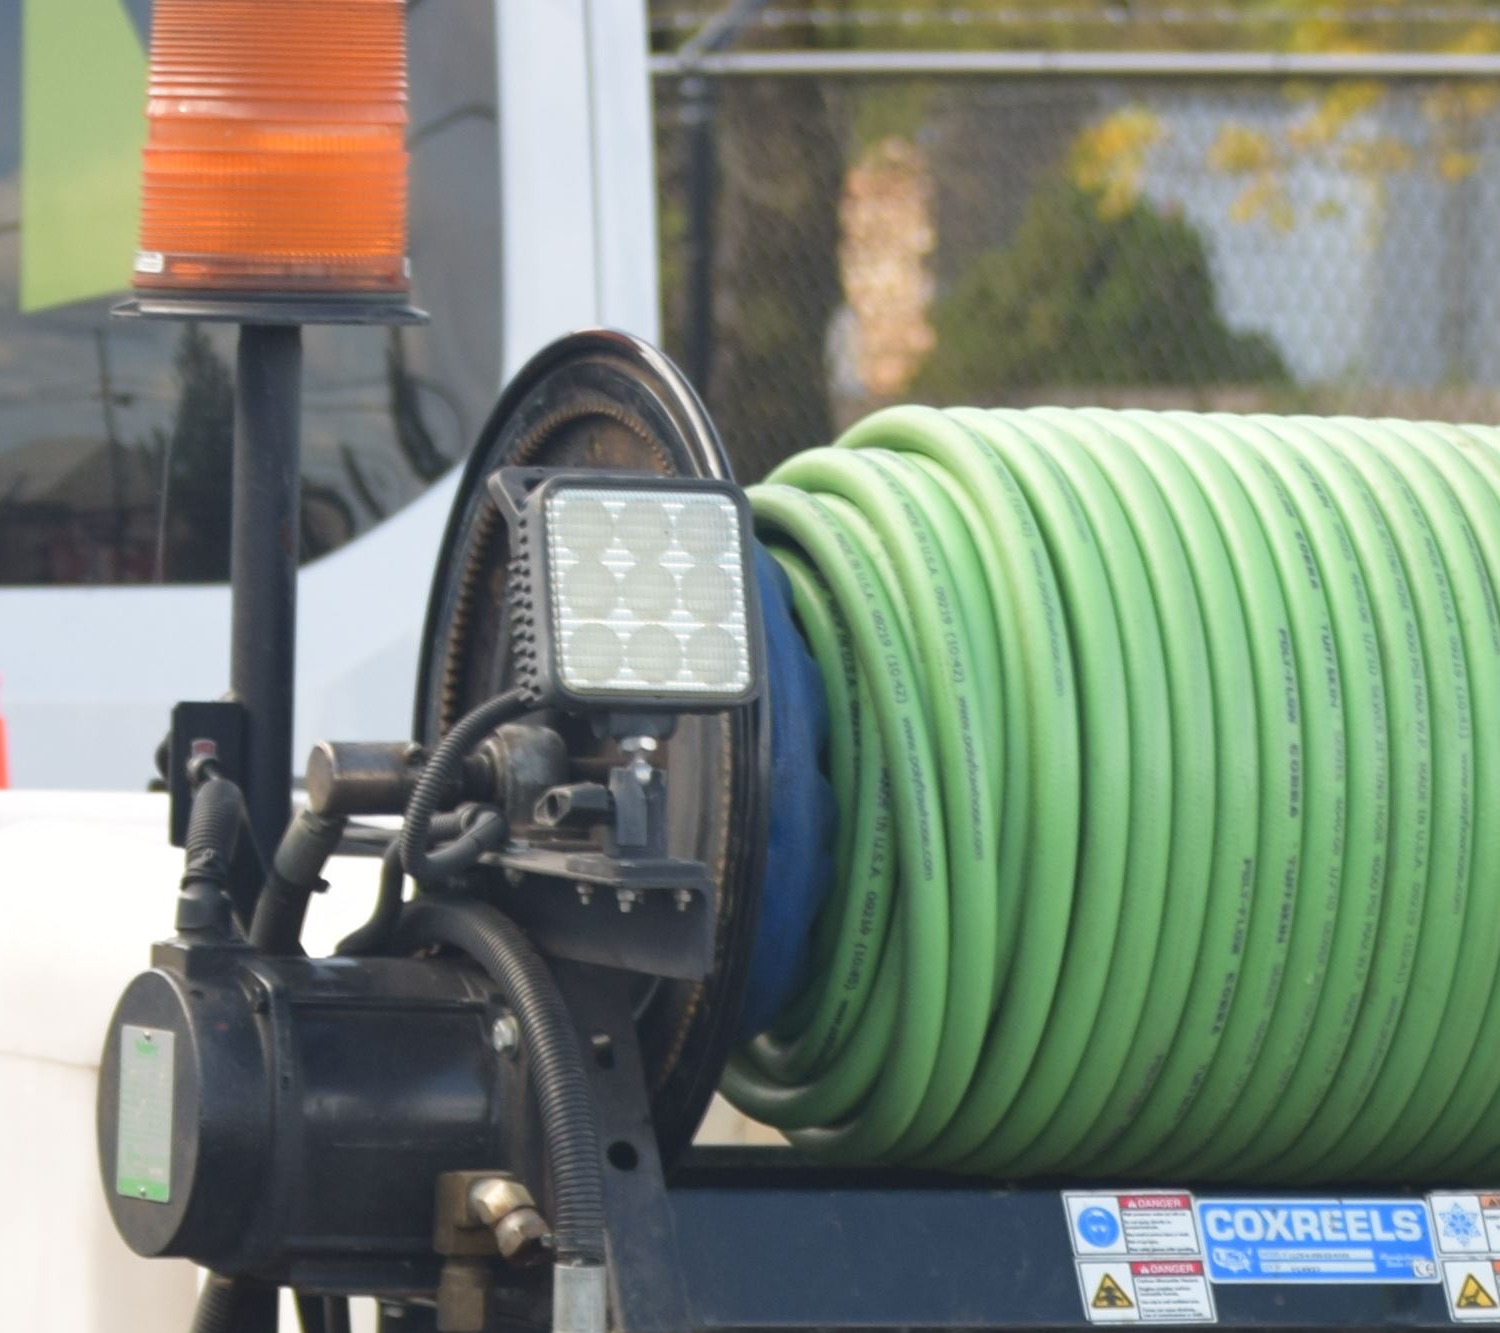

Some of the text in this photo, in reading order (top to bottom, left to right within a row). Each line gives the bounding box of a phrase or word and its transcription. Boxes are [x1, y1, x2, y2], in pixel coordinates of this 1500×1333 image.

[1138, 1199, 1182, 1208] DANGER
[1204, 1208, 1422, 1242] COXREELS
[1150, 1264, 1194, 1274] DANGER
